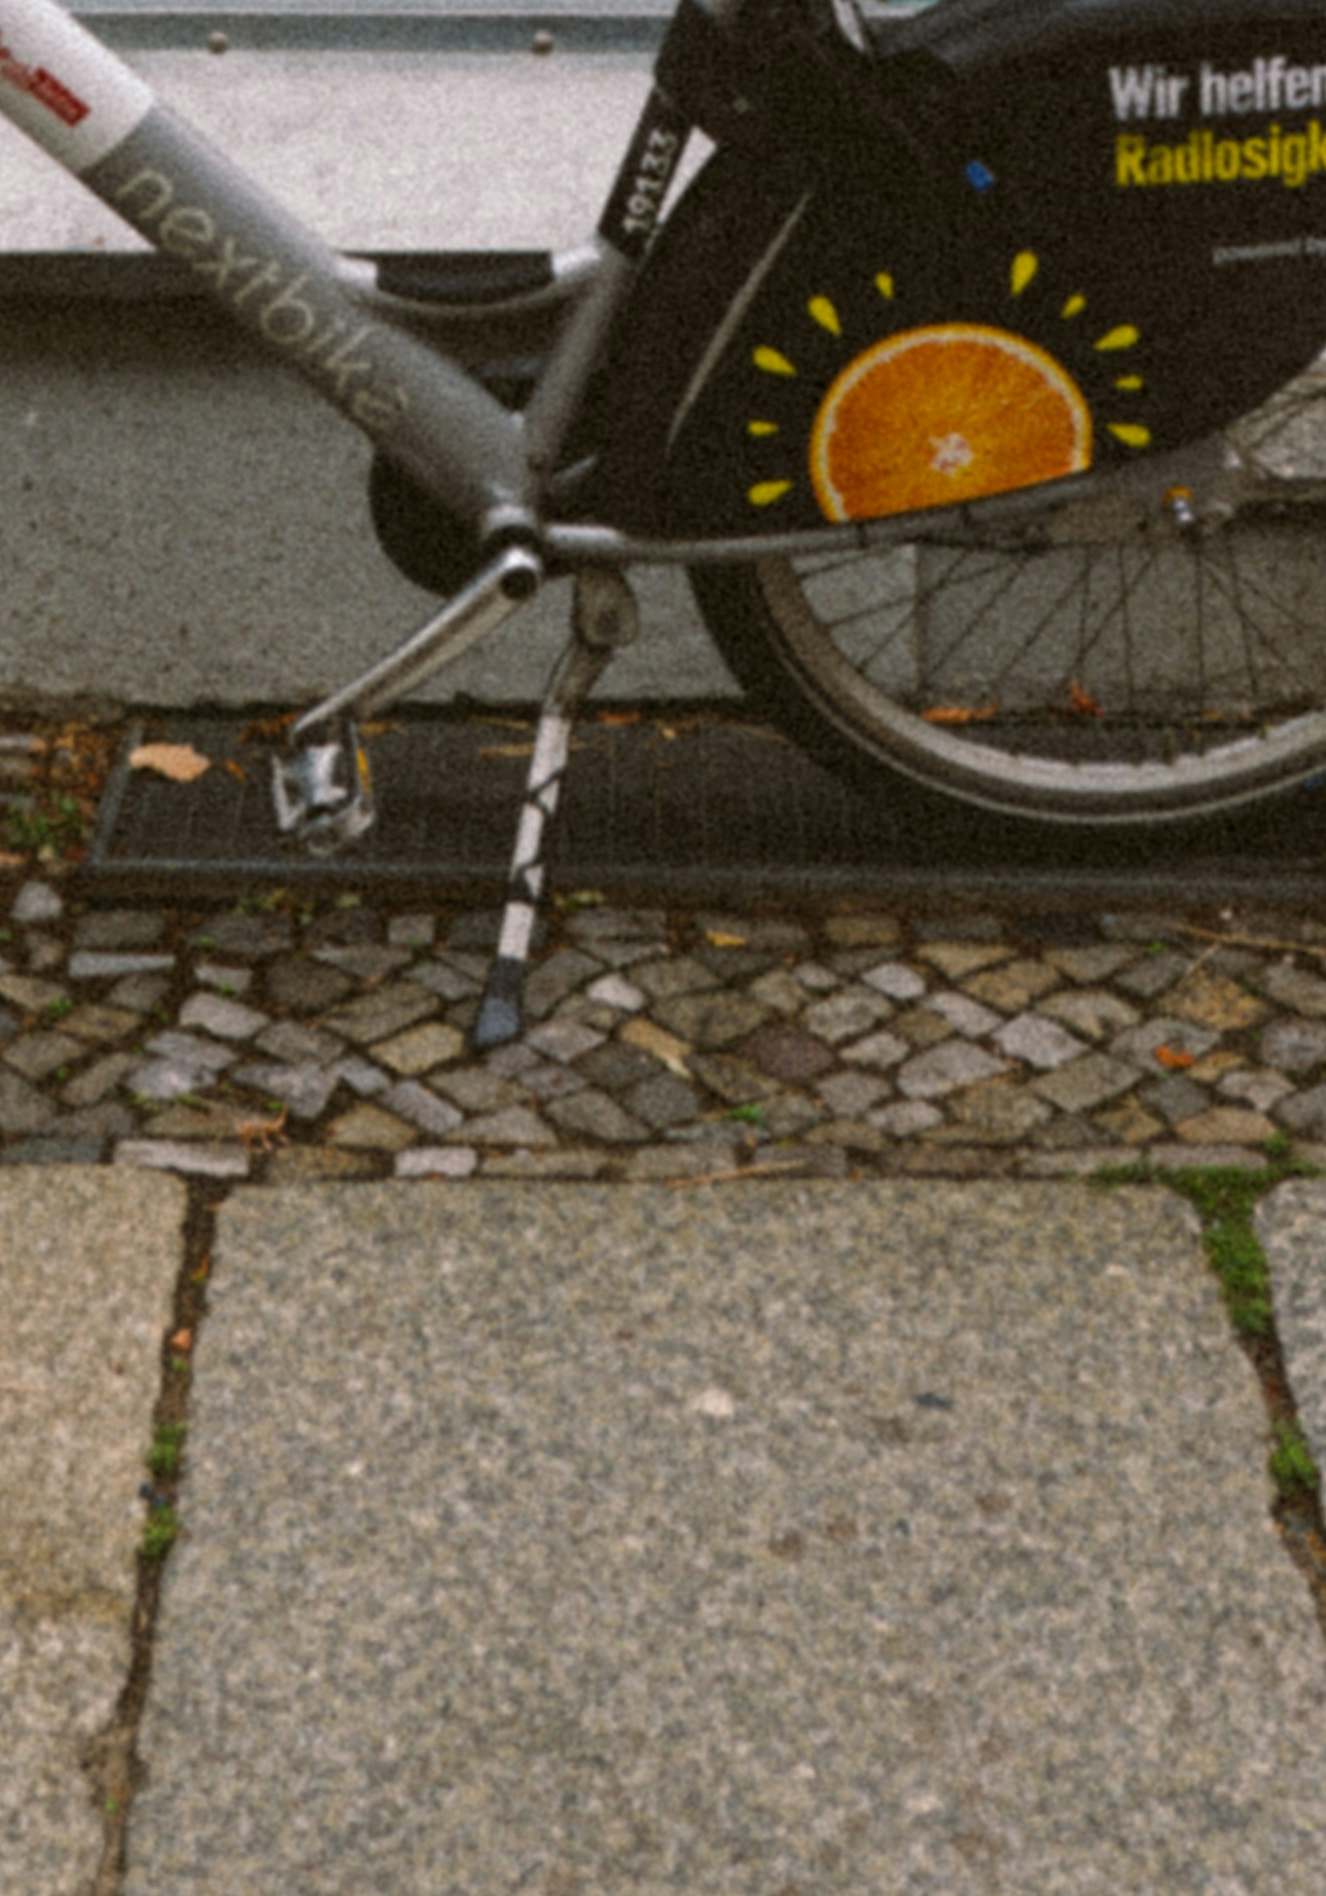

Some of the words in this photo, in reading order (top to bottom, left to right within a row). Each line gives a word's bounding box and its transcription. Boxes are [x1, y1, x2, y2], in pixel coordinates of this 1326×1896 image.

[1109, 63, 1189, 120] Wir
[621, 129, 679, 234] 19133
[116, 168, 409, 426] nextbike
